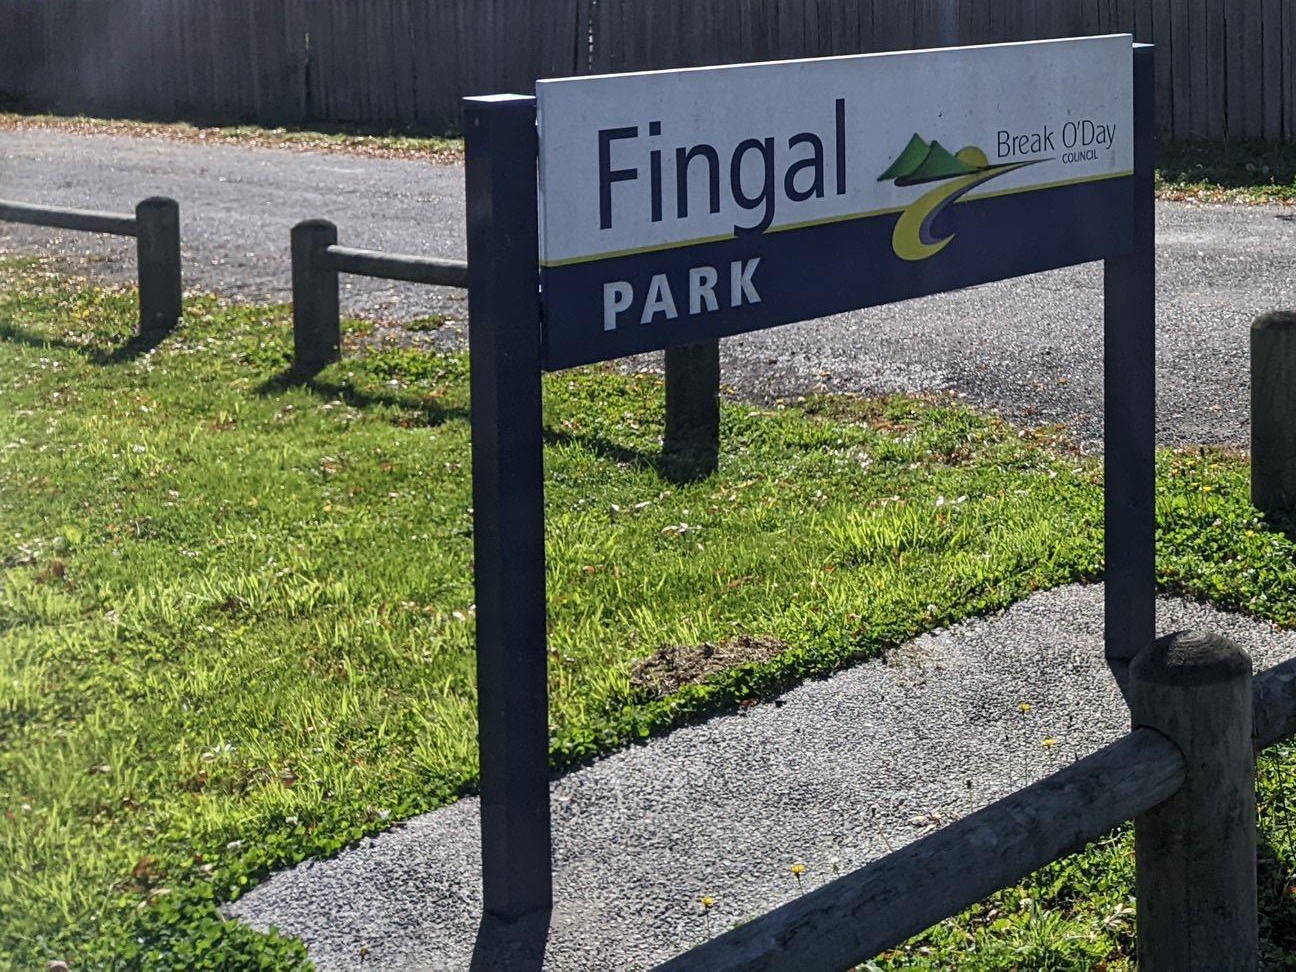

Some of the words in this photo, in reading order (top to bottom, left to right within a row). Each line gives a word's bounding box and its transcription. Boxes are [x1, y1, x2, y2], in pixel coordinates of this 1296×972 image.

[997, 125, 1055, 158] Break
[1062, 119, 1116, 150] O'Day
[1062, 150, 1099, 164] COUNCIL
[598, 98, 847, 237] Fingal
[603, 257, 762, 331] PARK
